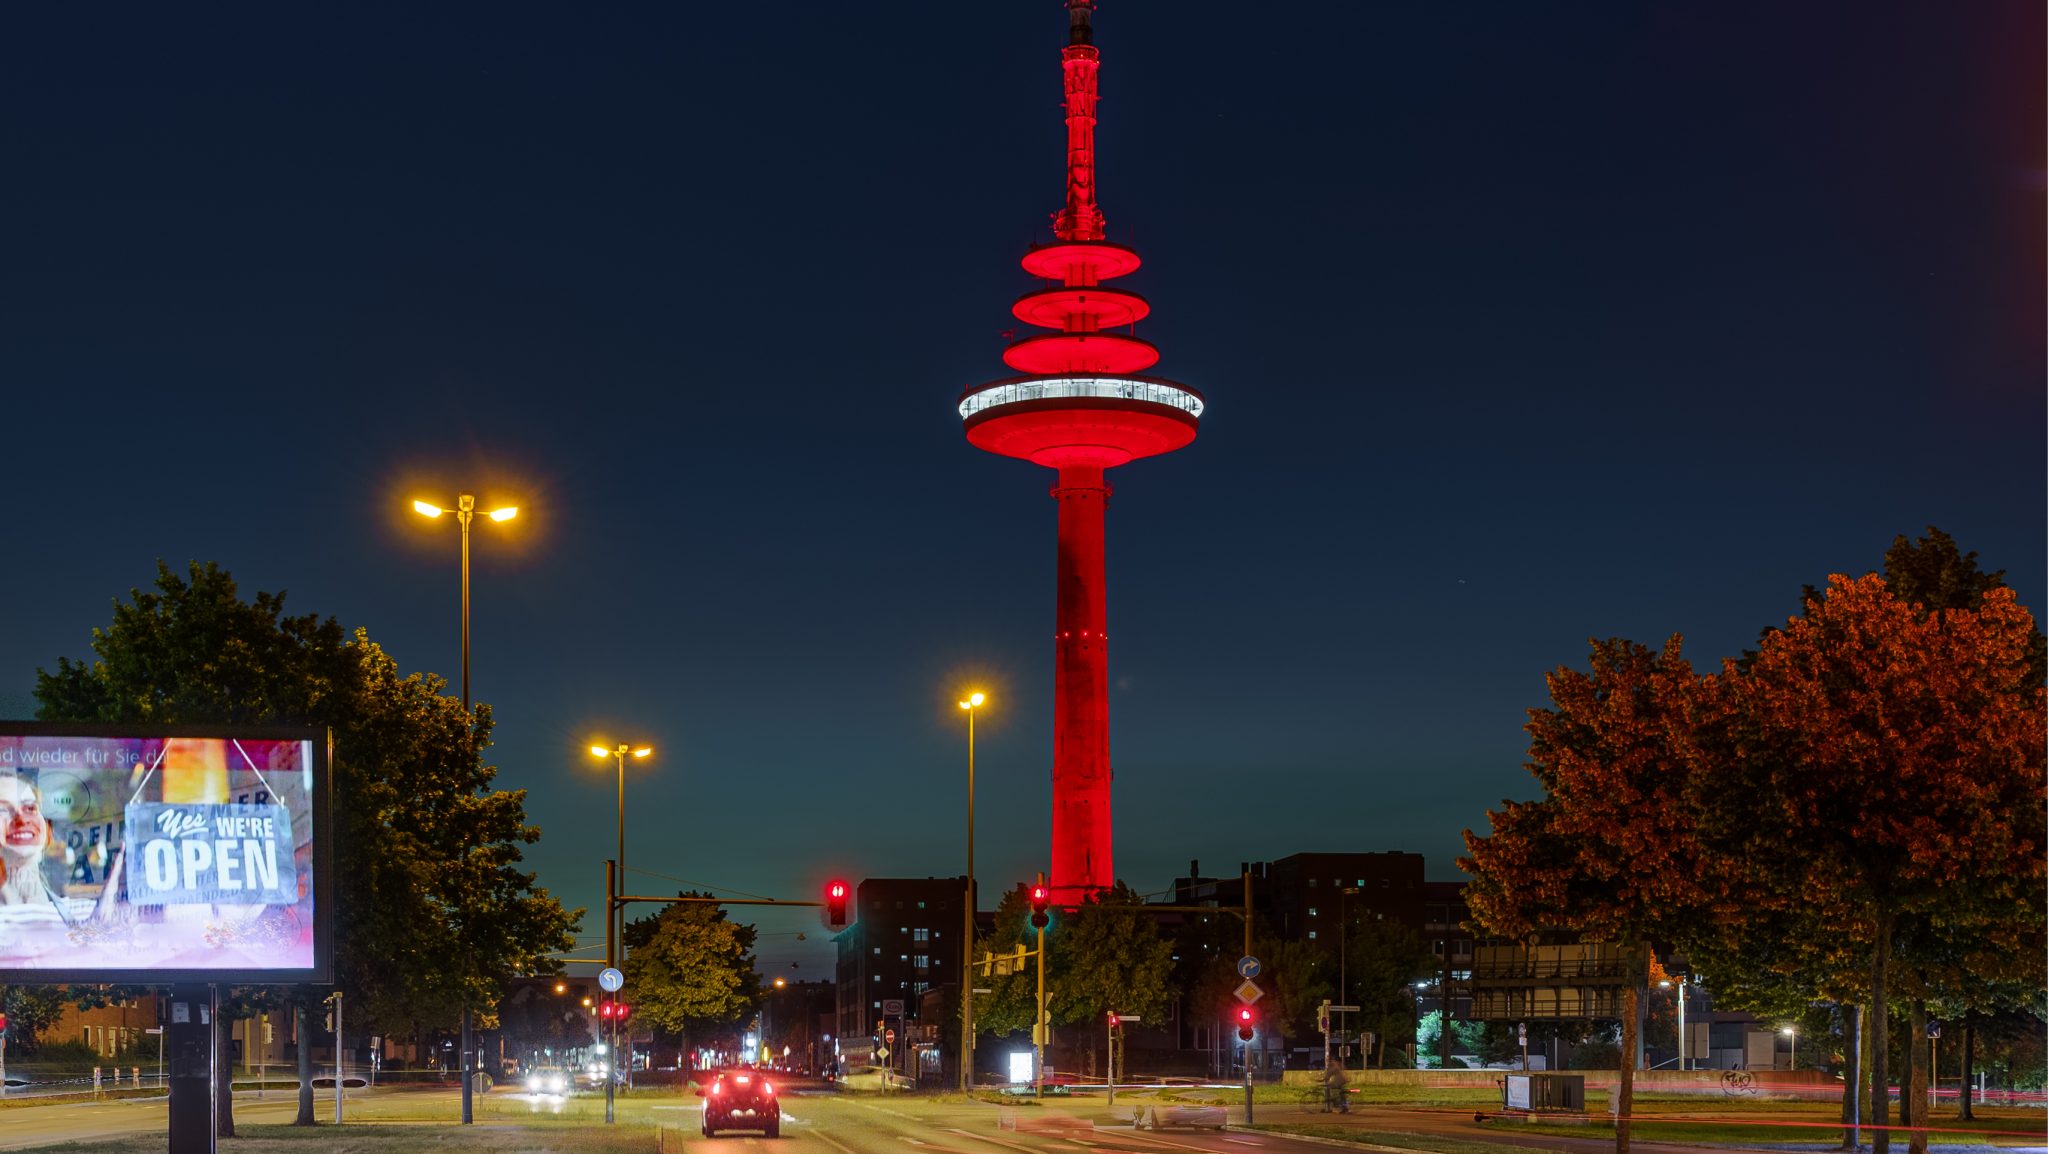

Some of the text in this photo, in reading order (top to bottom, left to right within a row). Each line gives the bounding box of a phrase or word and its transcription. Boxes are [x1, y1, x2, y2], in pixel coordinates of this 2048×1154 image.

[0, 748, 13, 763] d
[19, 747, 78, 763] wieder
[85, 746, 109, 763] für
[116, 749, 140, 764] Sie
[157, 809, 275, 839] Yes WE'RE
[144, 838, 279, 891] OPEN
